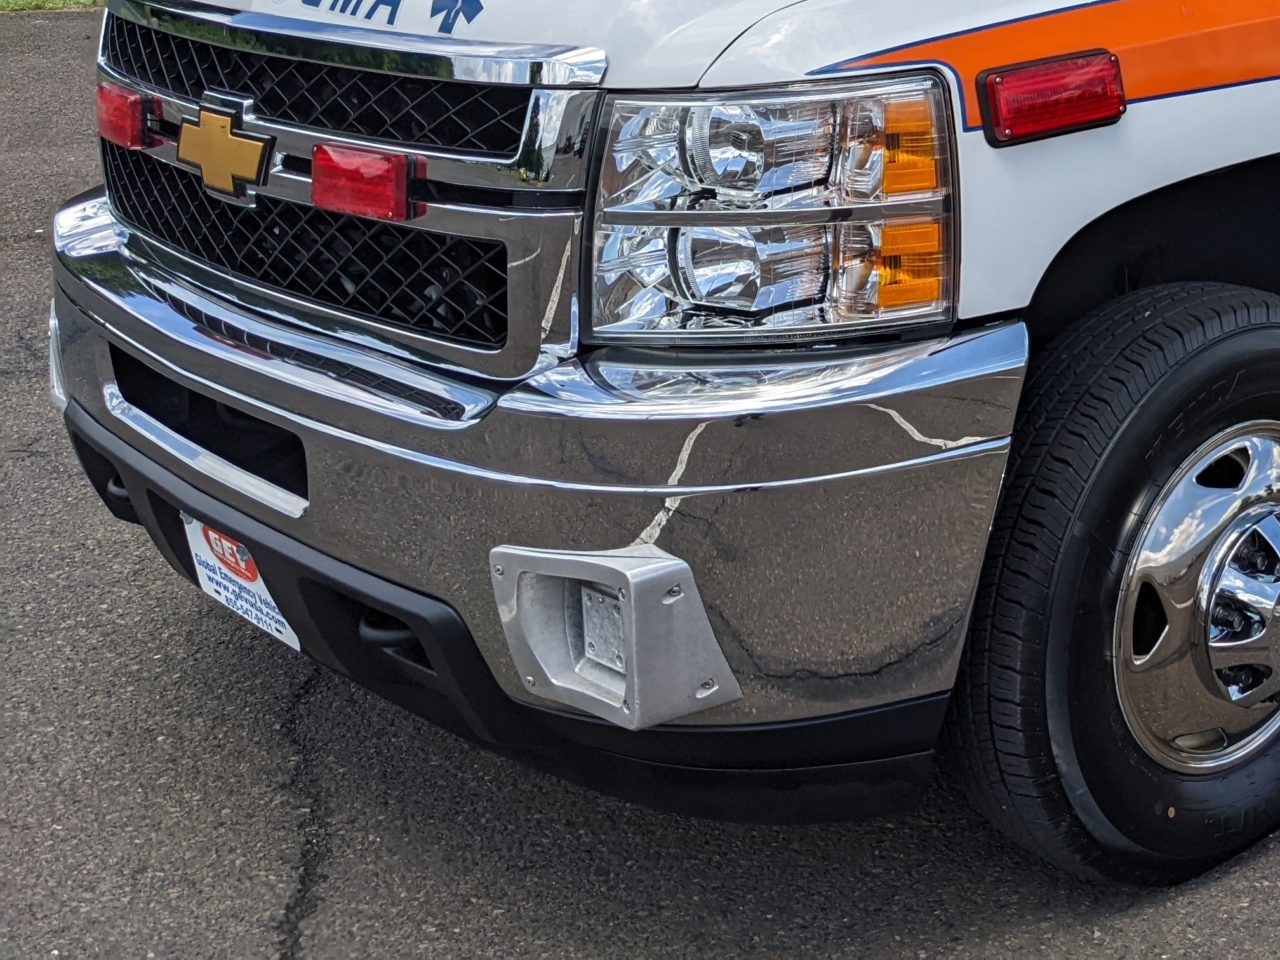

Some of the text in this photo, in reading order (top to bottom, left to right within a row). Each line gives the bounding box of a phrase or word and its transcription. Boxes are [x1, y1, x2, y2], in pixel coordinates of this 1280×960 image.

[194, 553, 219, 577] Global
[217, 566, 257, 599] Emergency
[206, 573, 288, 630] www.gevusa.com
